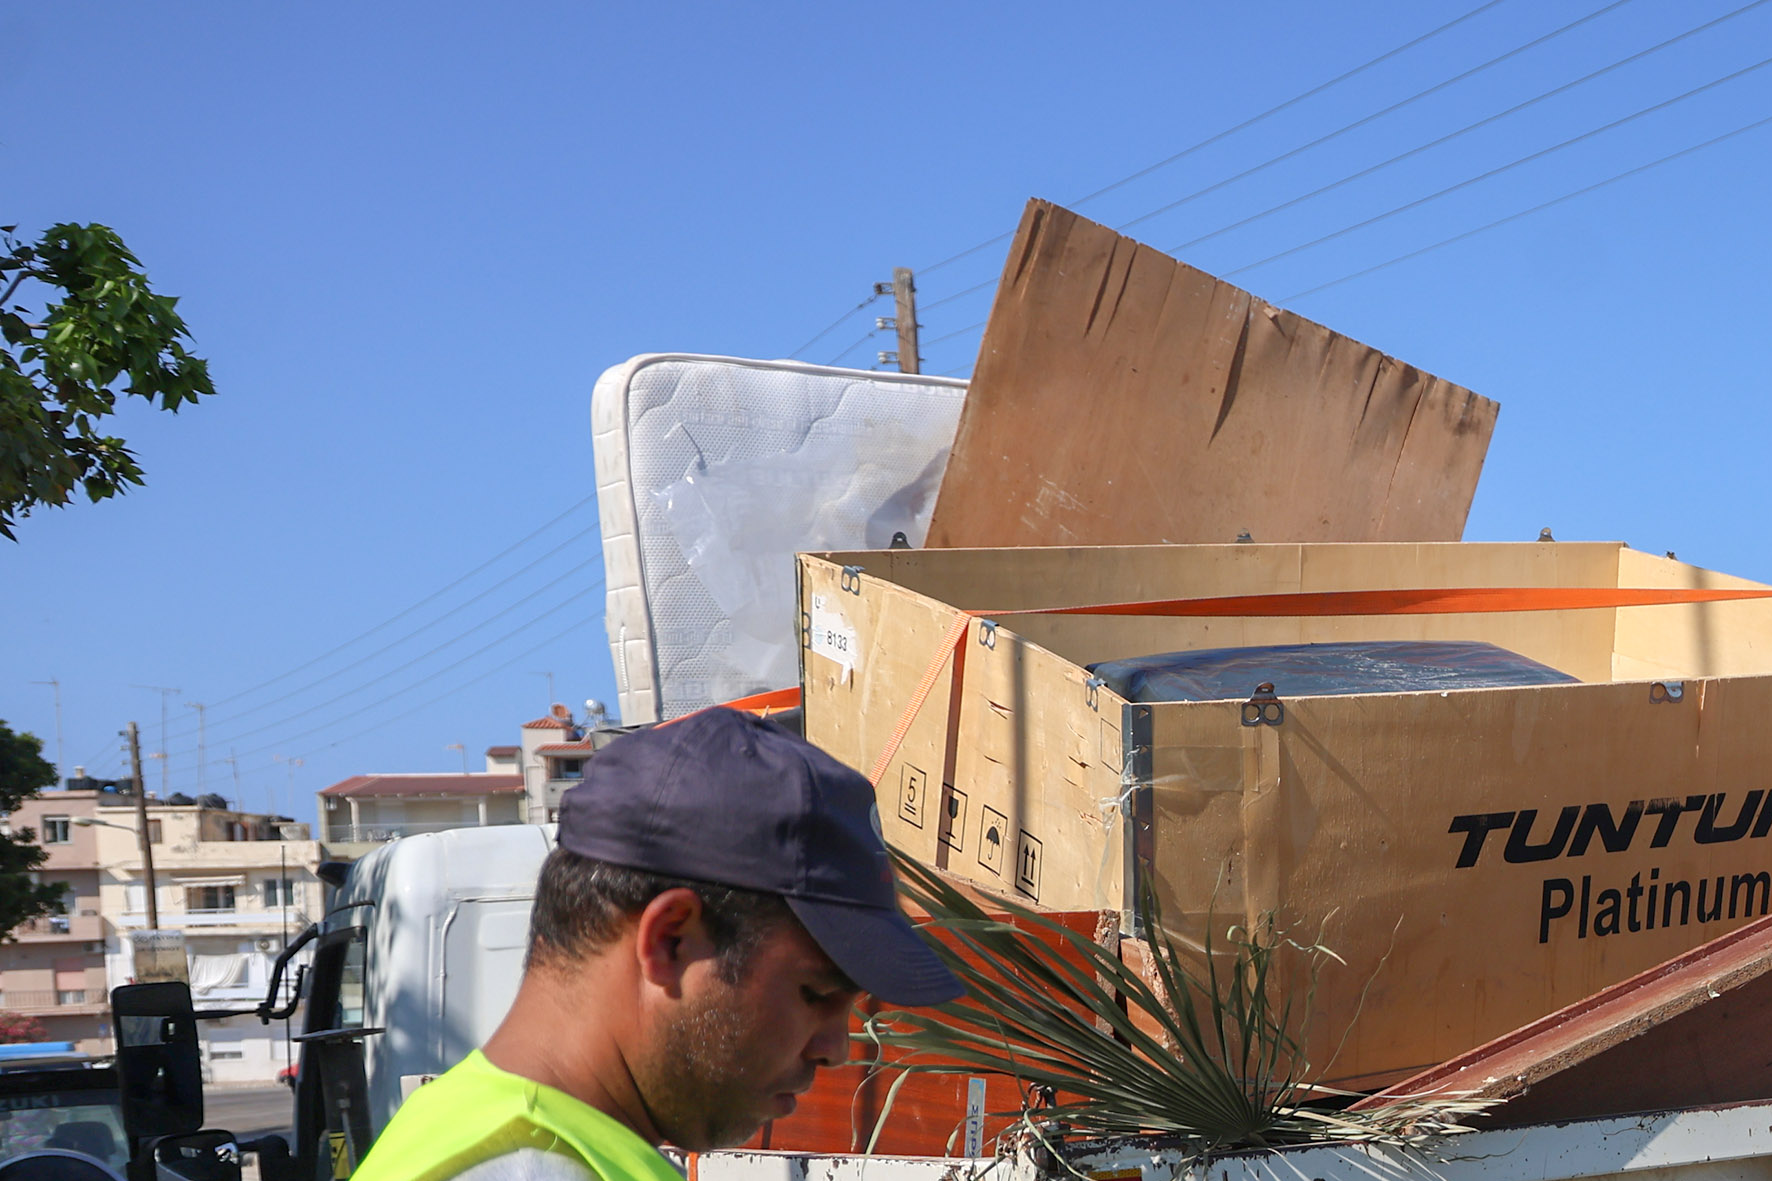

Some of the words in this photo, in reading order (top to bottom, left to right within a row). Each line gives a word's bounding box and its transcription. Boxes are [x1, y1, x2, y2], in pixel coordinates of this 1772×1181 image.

[827, 630, 847, 652] 8133
[907, 779, 917, 804] 5
[1538, 867, 1772, 944] Platinum
